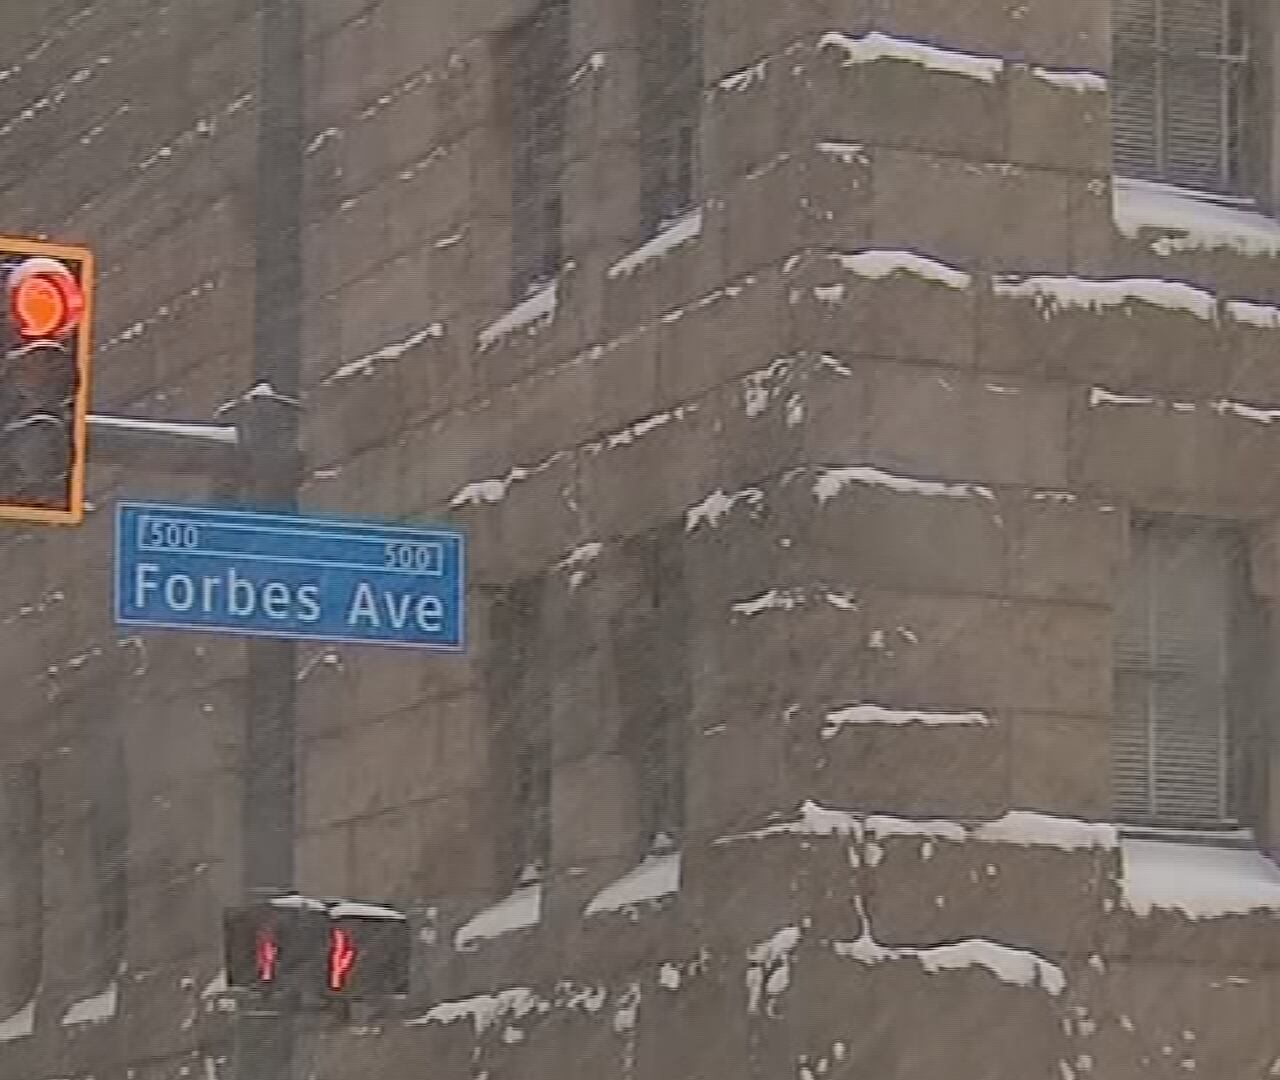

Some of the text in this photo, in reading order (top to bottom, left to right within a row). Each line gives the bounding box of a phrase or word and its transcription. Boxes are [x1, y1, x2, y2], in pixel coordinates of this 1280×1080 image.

[151, 521, 198, 548] 500
[383, 542, 432, 568] 500
[134, 563, 445, 632] Forbes Ave
